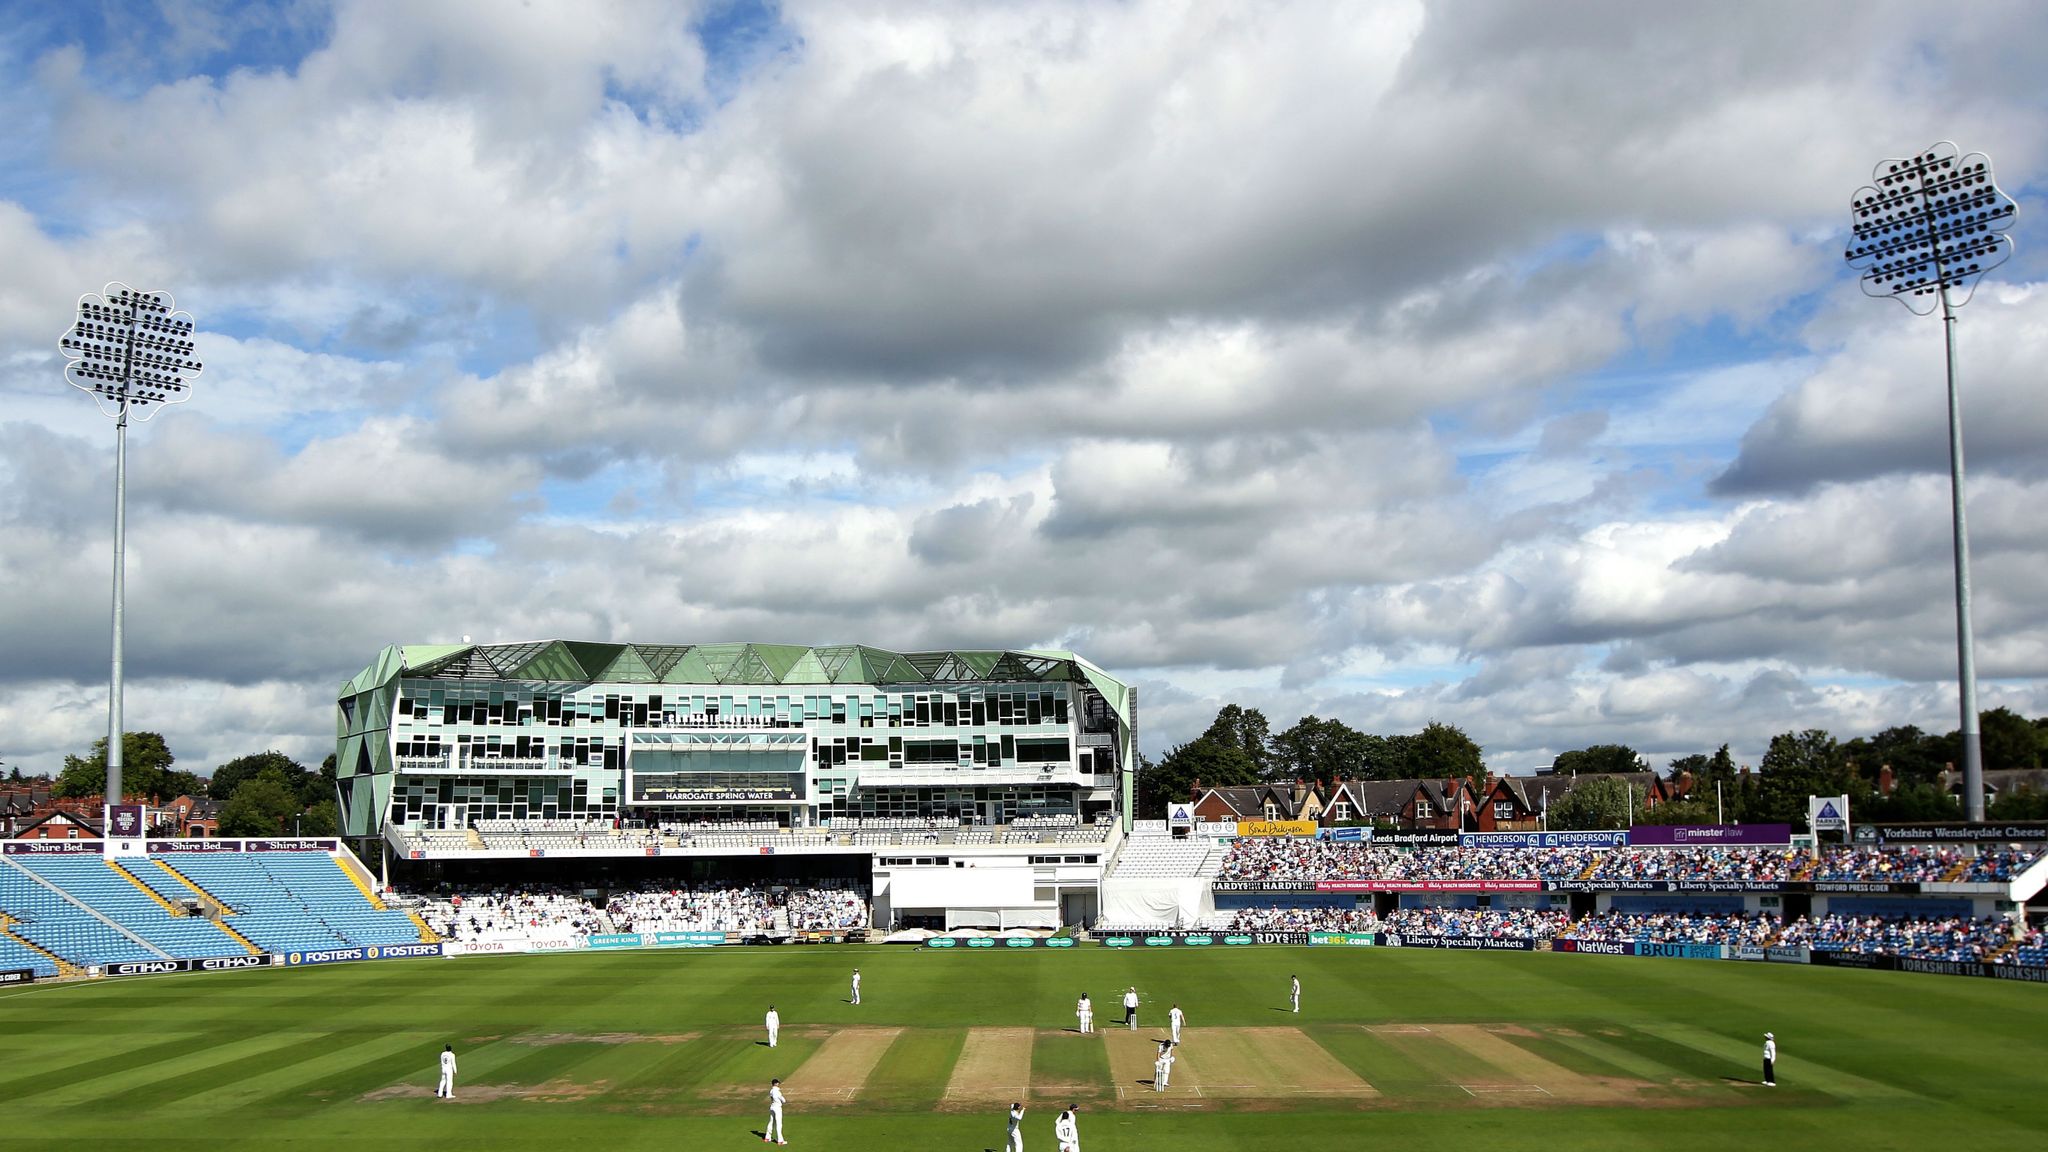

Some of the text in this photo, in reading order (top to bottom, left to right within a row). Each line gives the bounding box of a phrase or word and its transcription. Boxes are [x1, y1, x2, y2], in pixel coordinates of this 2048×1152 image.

[666, 792, 774, 800] HARROGATE SPRING WATER
[1248, 822, 1268, 835] Bond
[1268, 822, 1303, 835] Dickinson
[1688, 828, 1724, 837] minster
[1884, 827, 2046, 840] Yorkshire Wensleydale Cheese
[1372, 833, 1458, 843] Leeds Bradford Airport
[1475, 835, 1526, 843] HENDERSON
[1560, 833, 1611, 842] HENDERSON
[30, 843, 62, 852] Shire
[64, 843, 83, 852] Bed
[171, 841, 202, 850] Shire
[203, 841, 221, 850] Bed
[270, 840, 299, 849] Shire
[300, 840, 319, 849] Bed
[1263, 882, 1302, 890] HARDYS
[1560, 881, 1653, 891] Liberty Specialty Markets
[1680, 881, 1707, 891] Liberty
[1708, 882, 1743, 892] Specialty
[1848, 883, 1868, 892] PRESS
[1869, 883, 1889, 892] CIDER
[531, 940, 569, 949] TOYOTA
[593, 937, 618, 945] GREENE
[1311, 934, 1370, 945] bet365.com
[1406, 935, 1524, 950] Liberty Specialty Markets
[383, 944, 439, 956] FOSTER'S
[464, 943, 504, 951] TOYOTA
[1577, 942, 1624, 954] NatWest
[1640, 943, 1685, 958] BRUT
[306, 949, 362, 961] FOSTER'S
[1829, 952, 1877, 963] HARROGATE
[203, 956, 260, 969] ETIHAD
[119, 962, 178, 974] ETIHAD
[1901, 959, 1986, 977] YORKSHIRE TEA
[1062, 1127, 1070, 1137] 17
